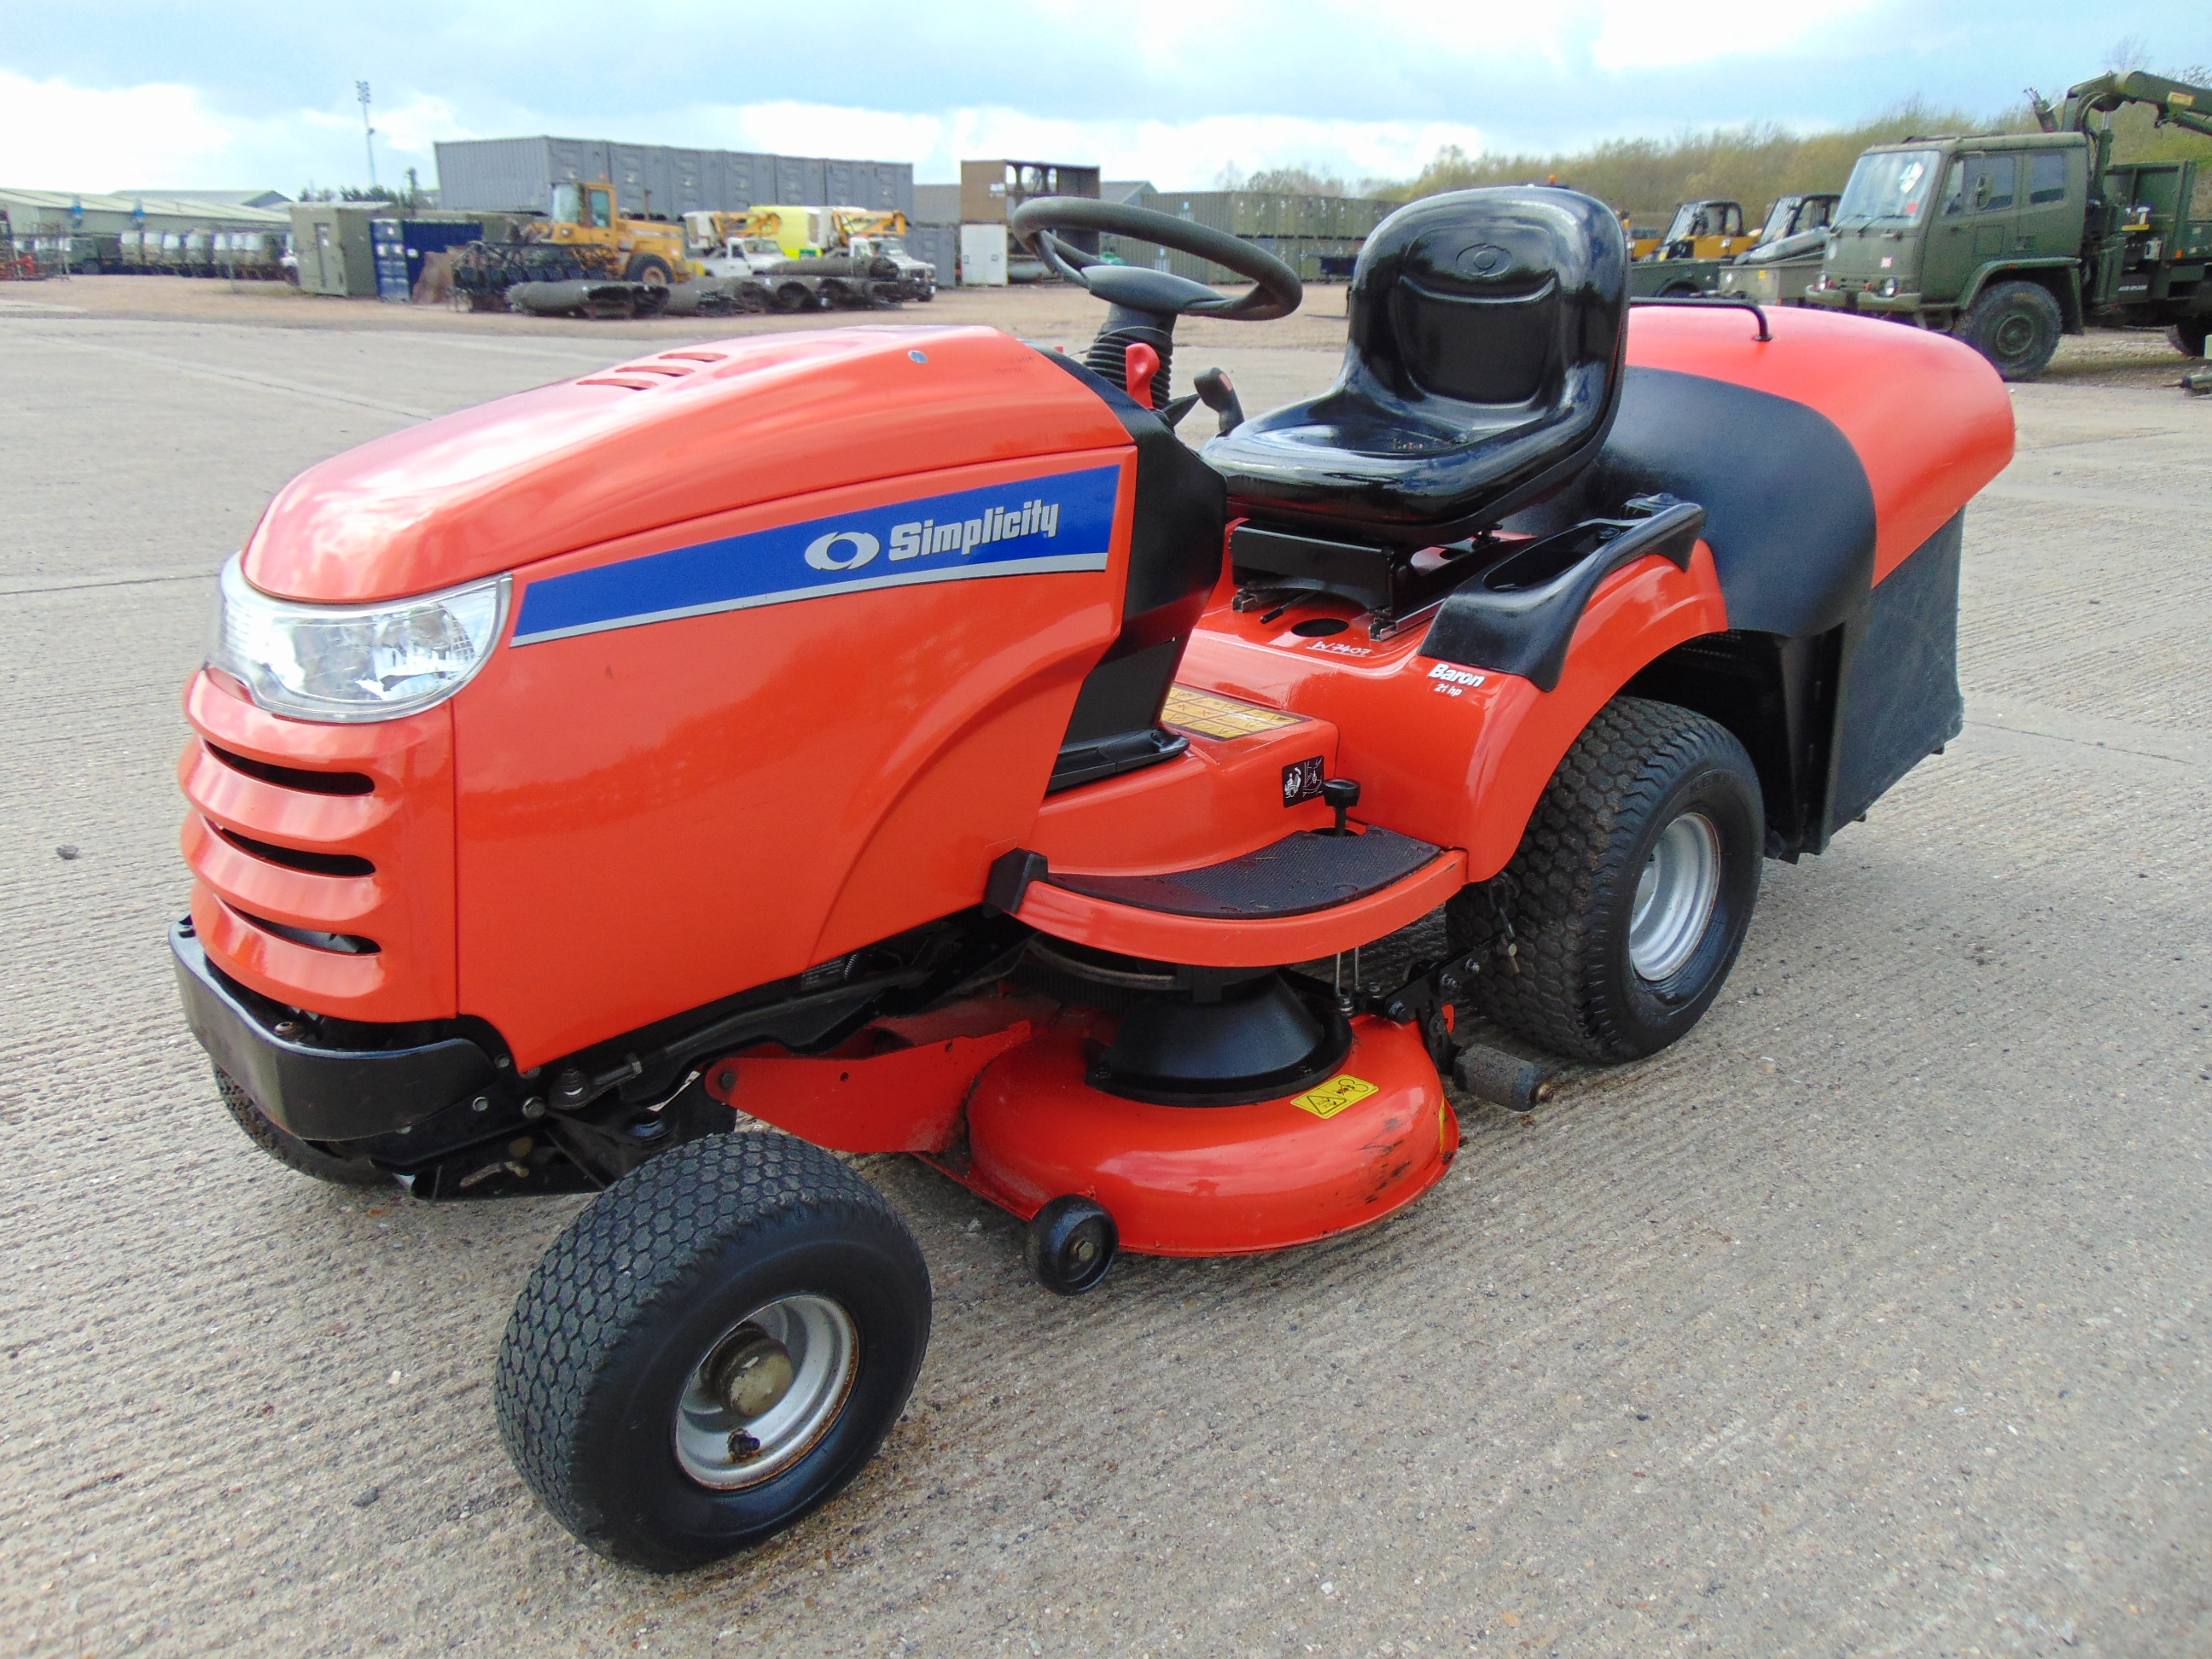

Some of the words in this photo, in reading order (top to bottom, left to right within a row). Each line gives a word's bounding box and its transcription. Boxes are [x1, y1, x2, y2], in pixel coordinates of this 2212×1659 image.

[888, 499, 1060, 561] Simplicity
[1427, 663, 1485, 687] Baron
[1434, 684, 1449, 693] 21
[1447, 686, 1463, 697] hp
